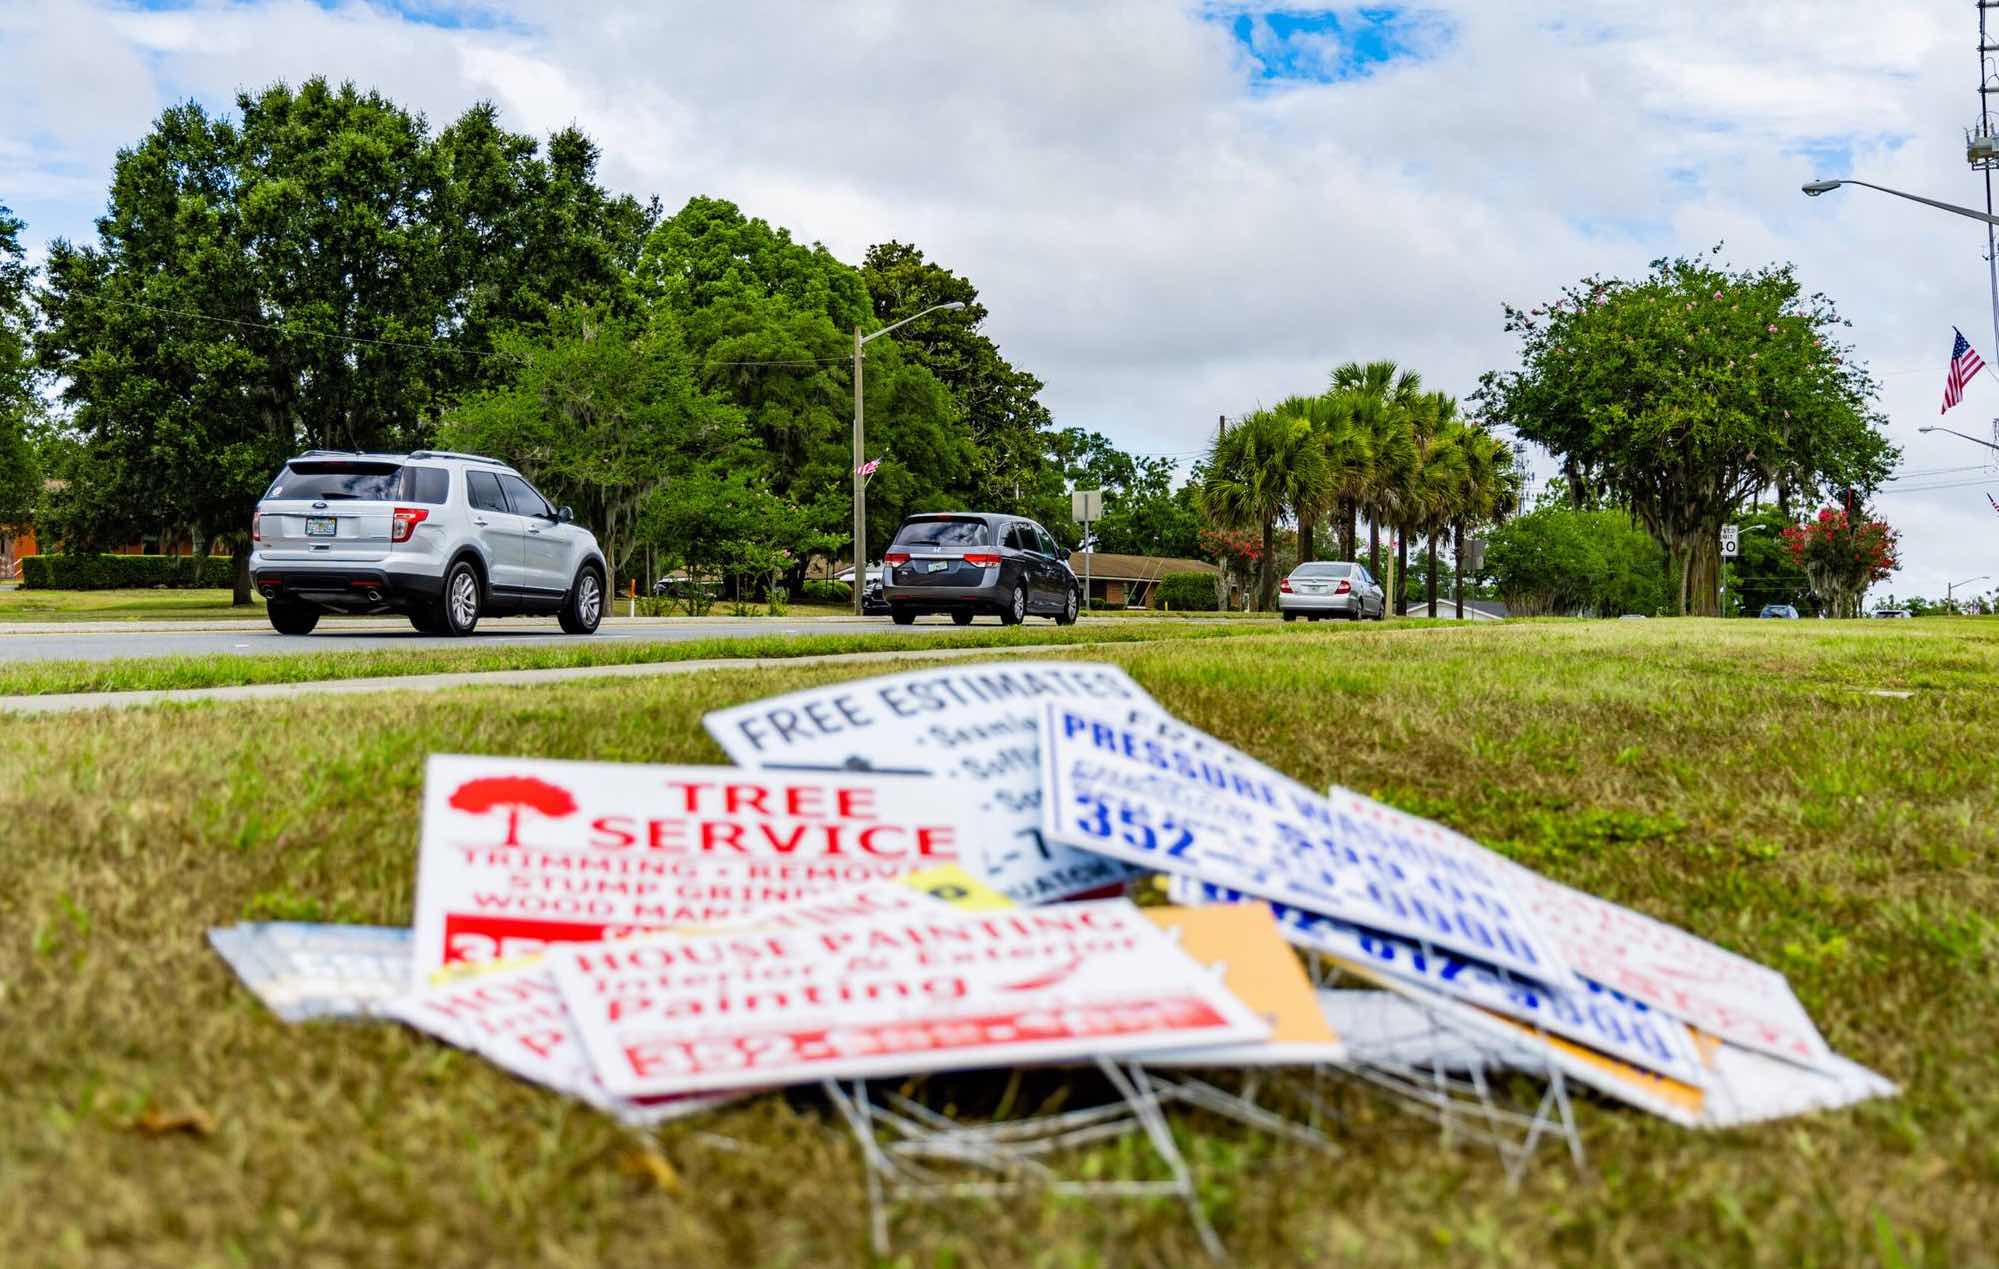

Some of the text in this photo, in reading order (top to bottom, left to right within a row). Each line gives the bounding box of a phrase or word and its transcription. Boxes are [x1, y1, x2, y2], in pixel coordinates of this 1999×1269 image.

[736, 669, 1132, 752] FREE ESTIMATES
[1062, 711, 1281, 808] PRESSURE
[667, 782, 877, 819] TREE
[588, 815, 960, 860] SERVICE
[461, 846, 912, 882] TRIMMING REMOV
[509, 874, 659, 897] STUMP
[471, 892, 615, 917] WOOD
[575, 937, 785, 974] HOUSE
[820, 910, 1128, 953] PAINTING
[597, 966, 813, 992] Interior
[915, 934, 1137, 965] Exterior
[607, 973, 968, 1022] Painting
